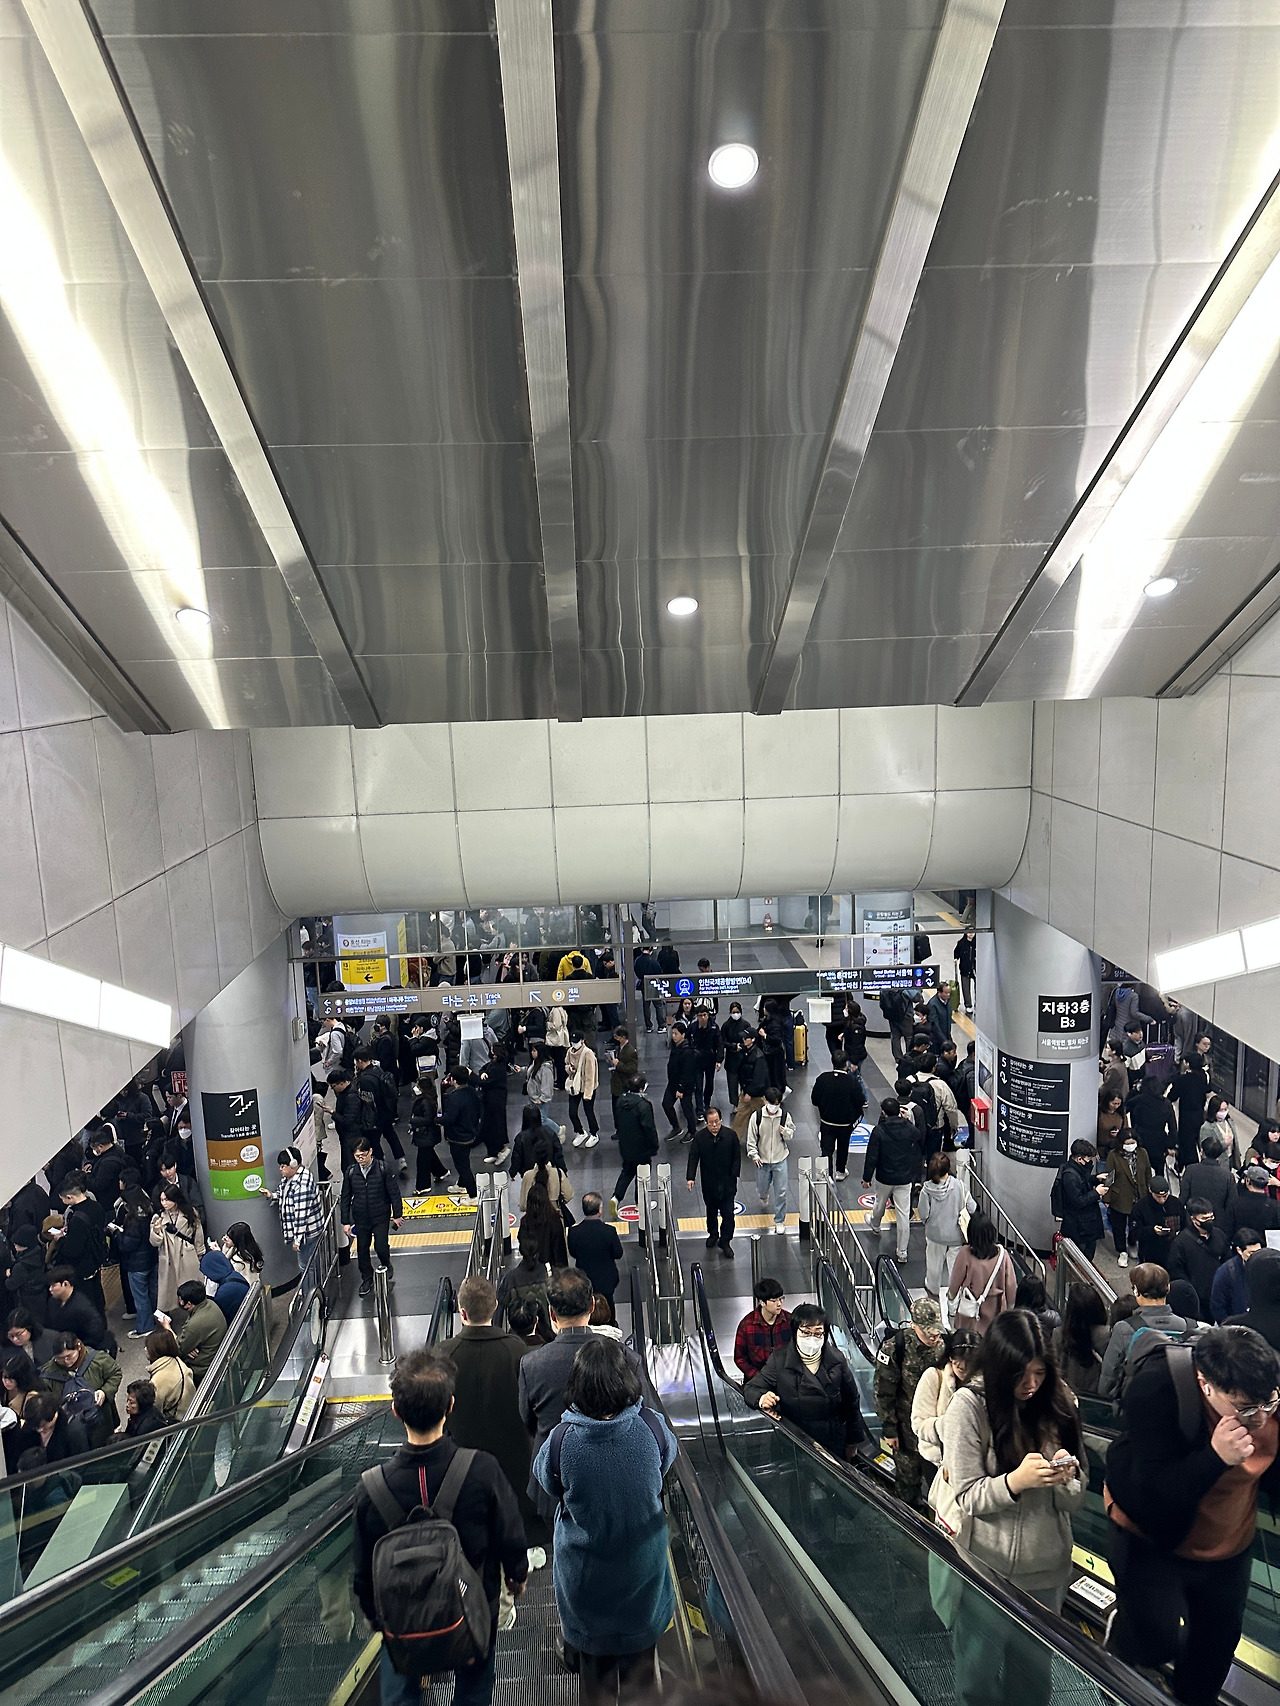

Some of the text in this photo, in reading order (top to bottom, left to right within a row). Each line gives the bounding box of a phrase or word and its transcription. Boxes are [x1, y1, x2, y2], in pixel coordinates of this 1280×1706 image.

[442, 995, 464, 1007] 타는
[467, 994, 478, 1006] 곳
[1042, 1000, 1090, 1015] 지하3층
[1060, 1016, 1076, 1028] B3
